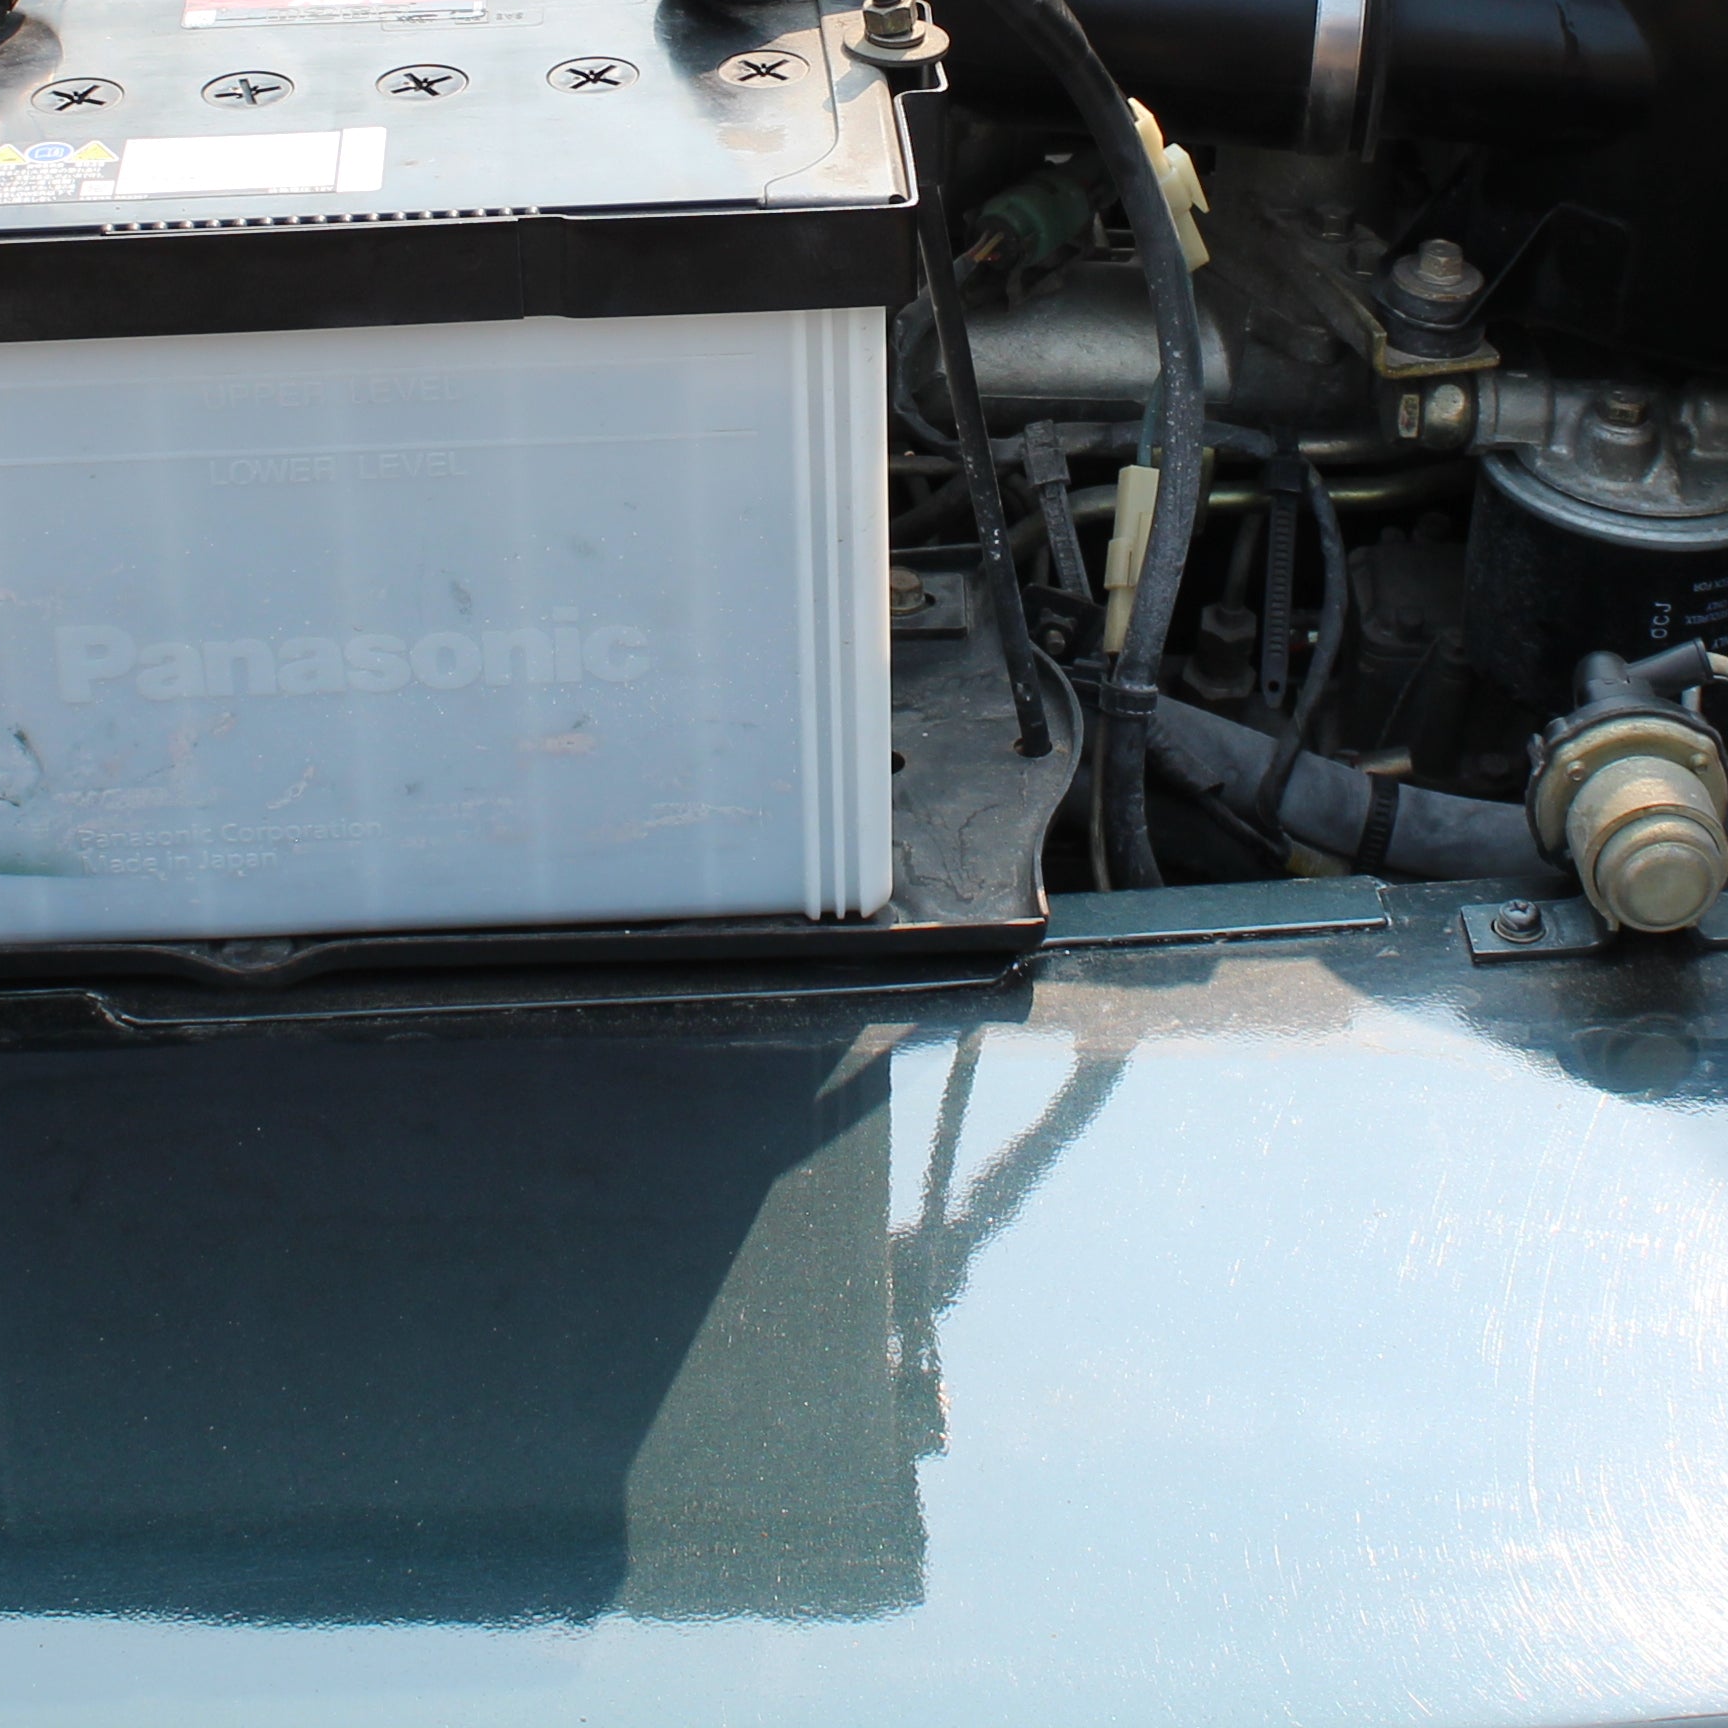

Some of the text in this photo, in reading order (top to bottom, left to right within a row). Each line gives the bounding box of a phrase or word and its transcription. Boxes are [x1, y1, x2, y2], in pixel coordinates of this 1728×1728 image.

[202, 376, 464, 410] UPPER LEVEL
[208, 451, 469, 486] LOWER LEVEL
[54, 605, 651, 706] Panasonic
[76, 817, 383, 849] Panasonic Corporation
[80, 847, 277, 876] Made in Japan
